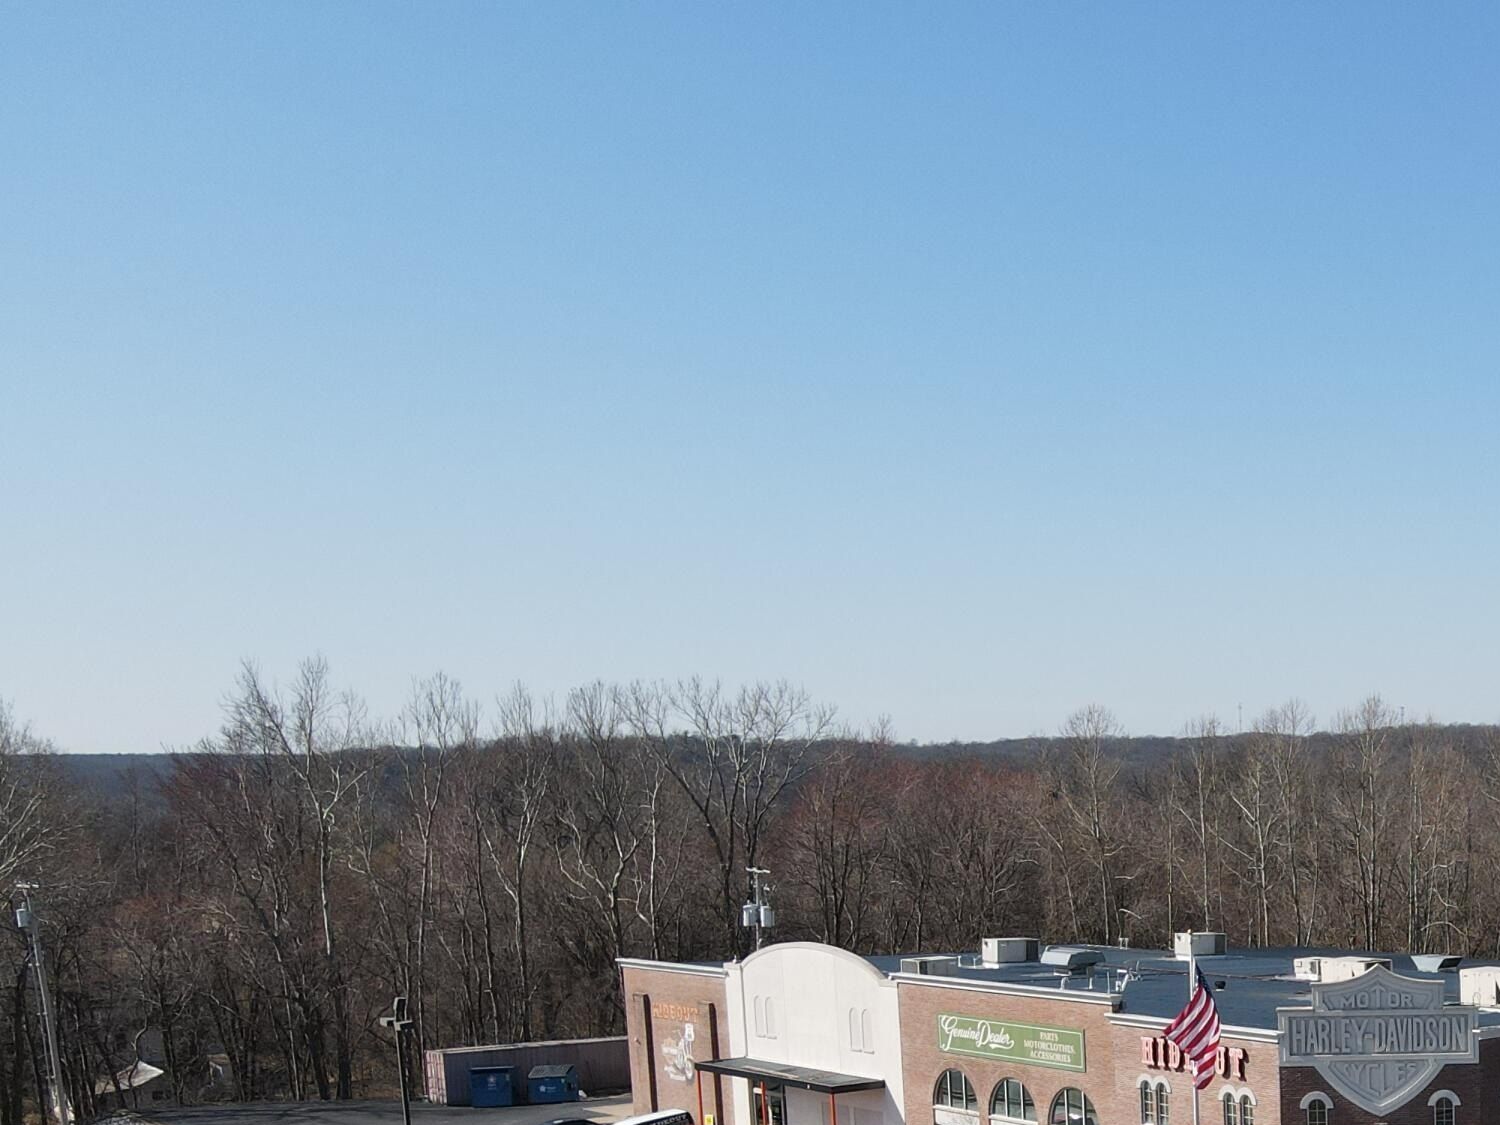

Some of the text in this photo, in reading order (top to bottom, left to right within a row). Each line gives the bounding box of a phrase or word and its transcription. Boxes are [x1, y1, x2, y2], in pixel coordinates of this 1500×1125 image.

[1340, 984, 1414, 1009] MOTOR
[1291, 1016, 1469, 1055] HARLEY-DAVIDSON
[1140, 1036, 1244, 1078] HIDUT
